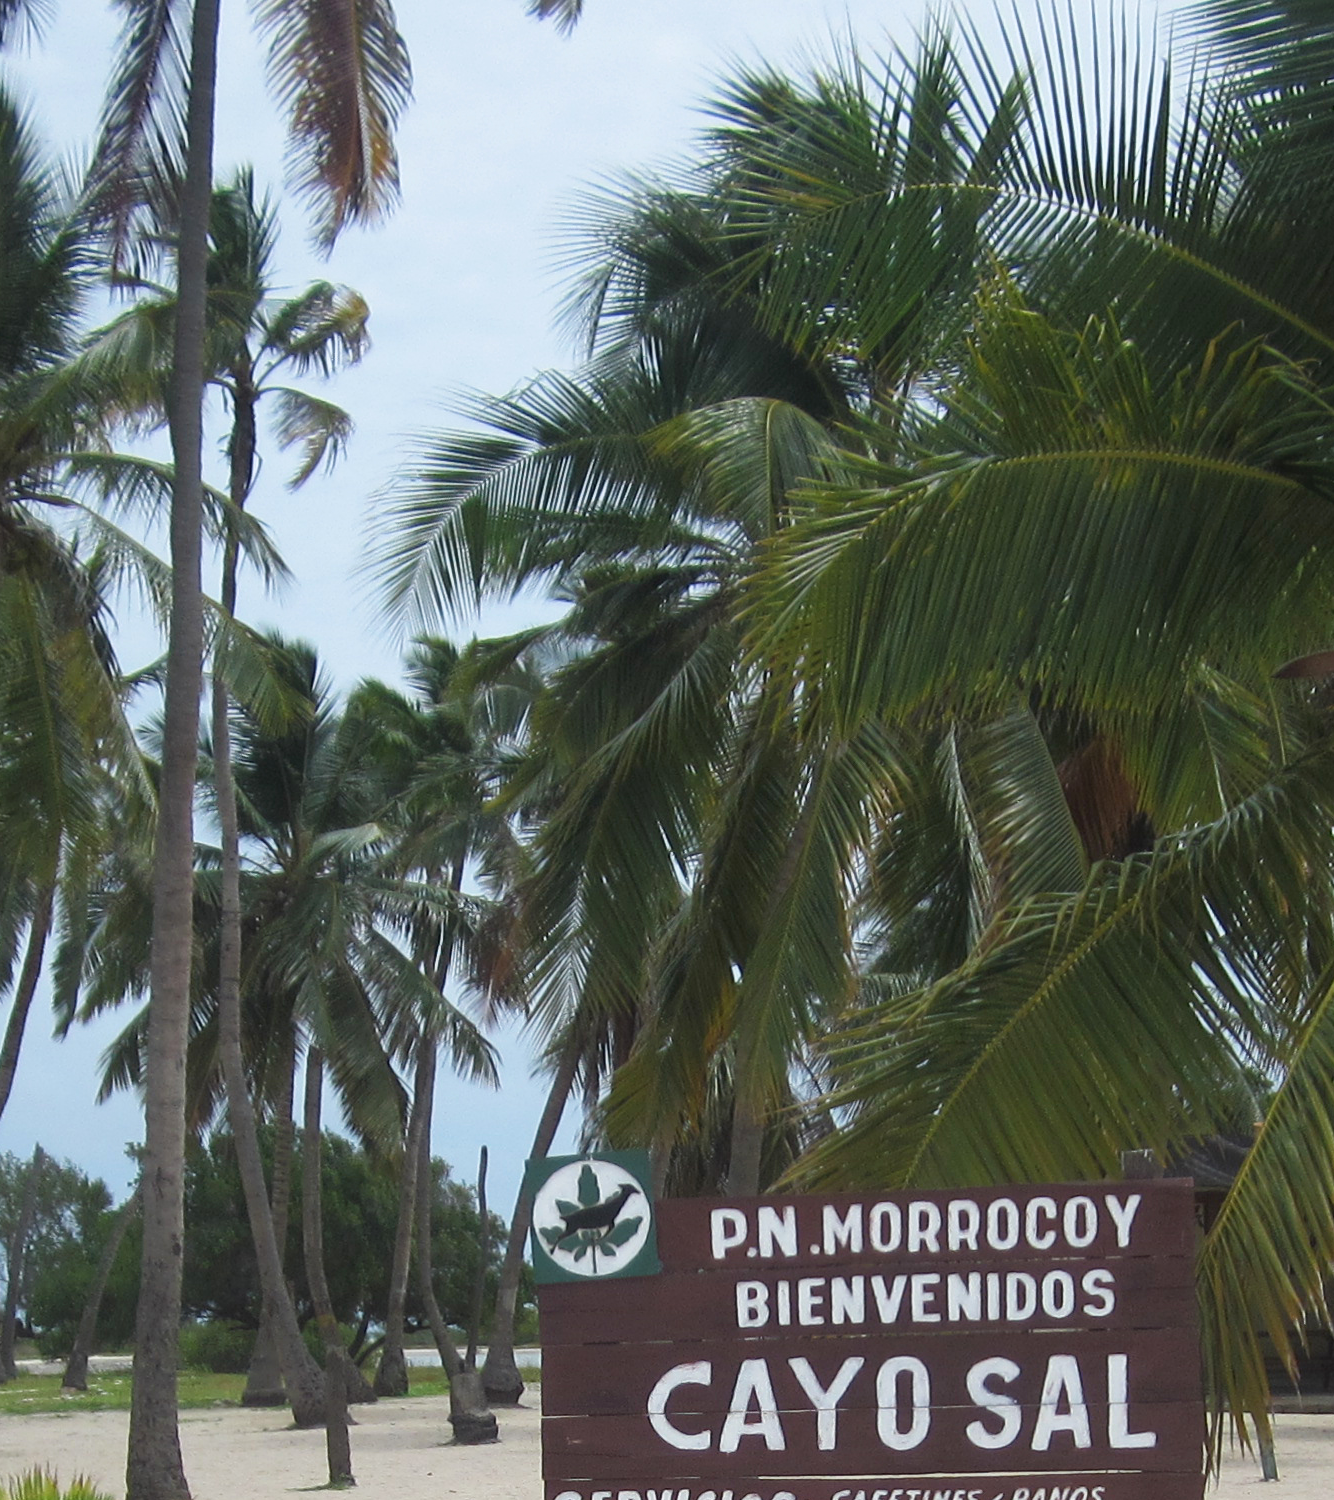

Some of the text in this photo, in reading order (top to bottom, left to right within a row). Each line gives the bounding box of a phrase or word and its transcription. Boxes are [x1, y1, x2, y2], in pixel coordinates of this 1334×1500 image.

[736, 1269, 1115, 1328] BIENVENIDOS
[647, 1353, 1157, 1453] CAYO SAL
